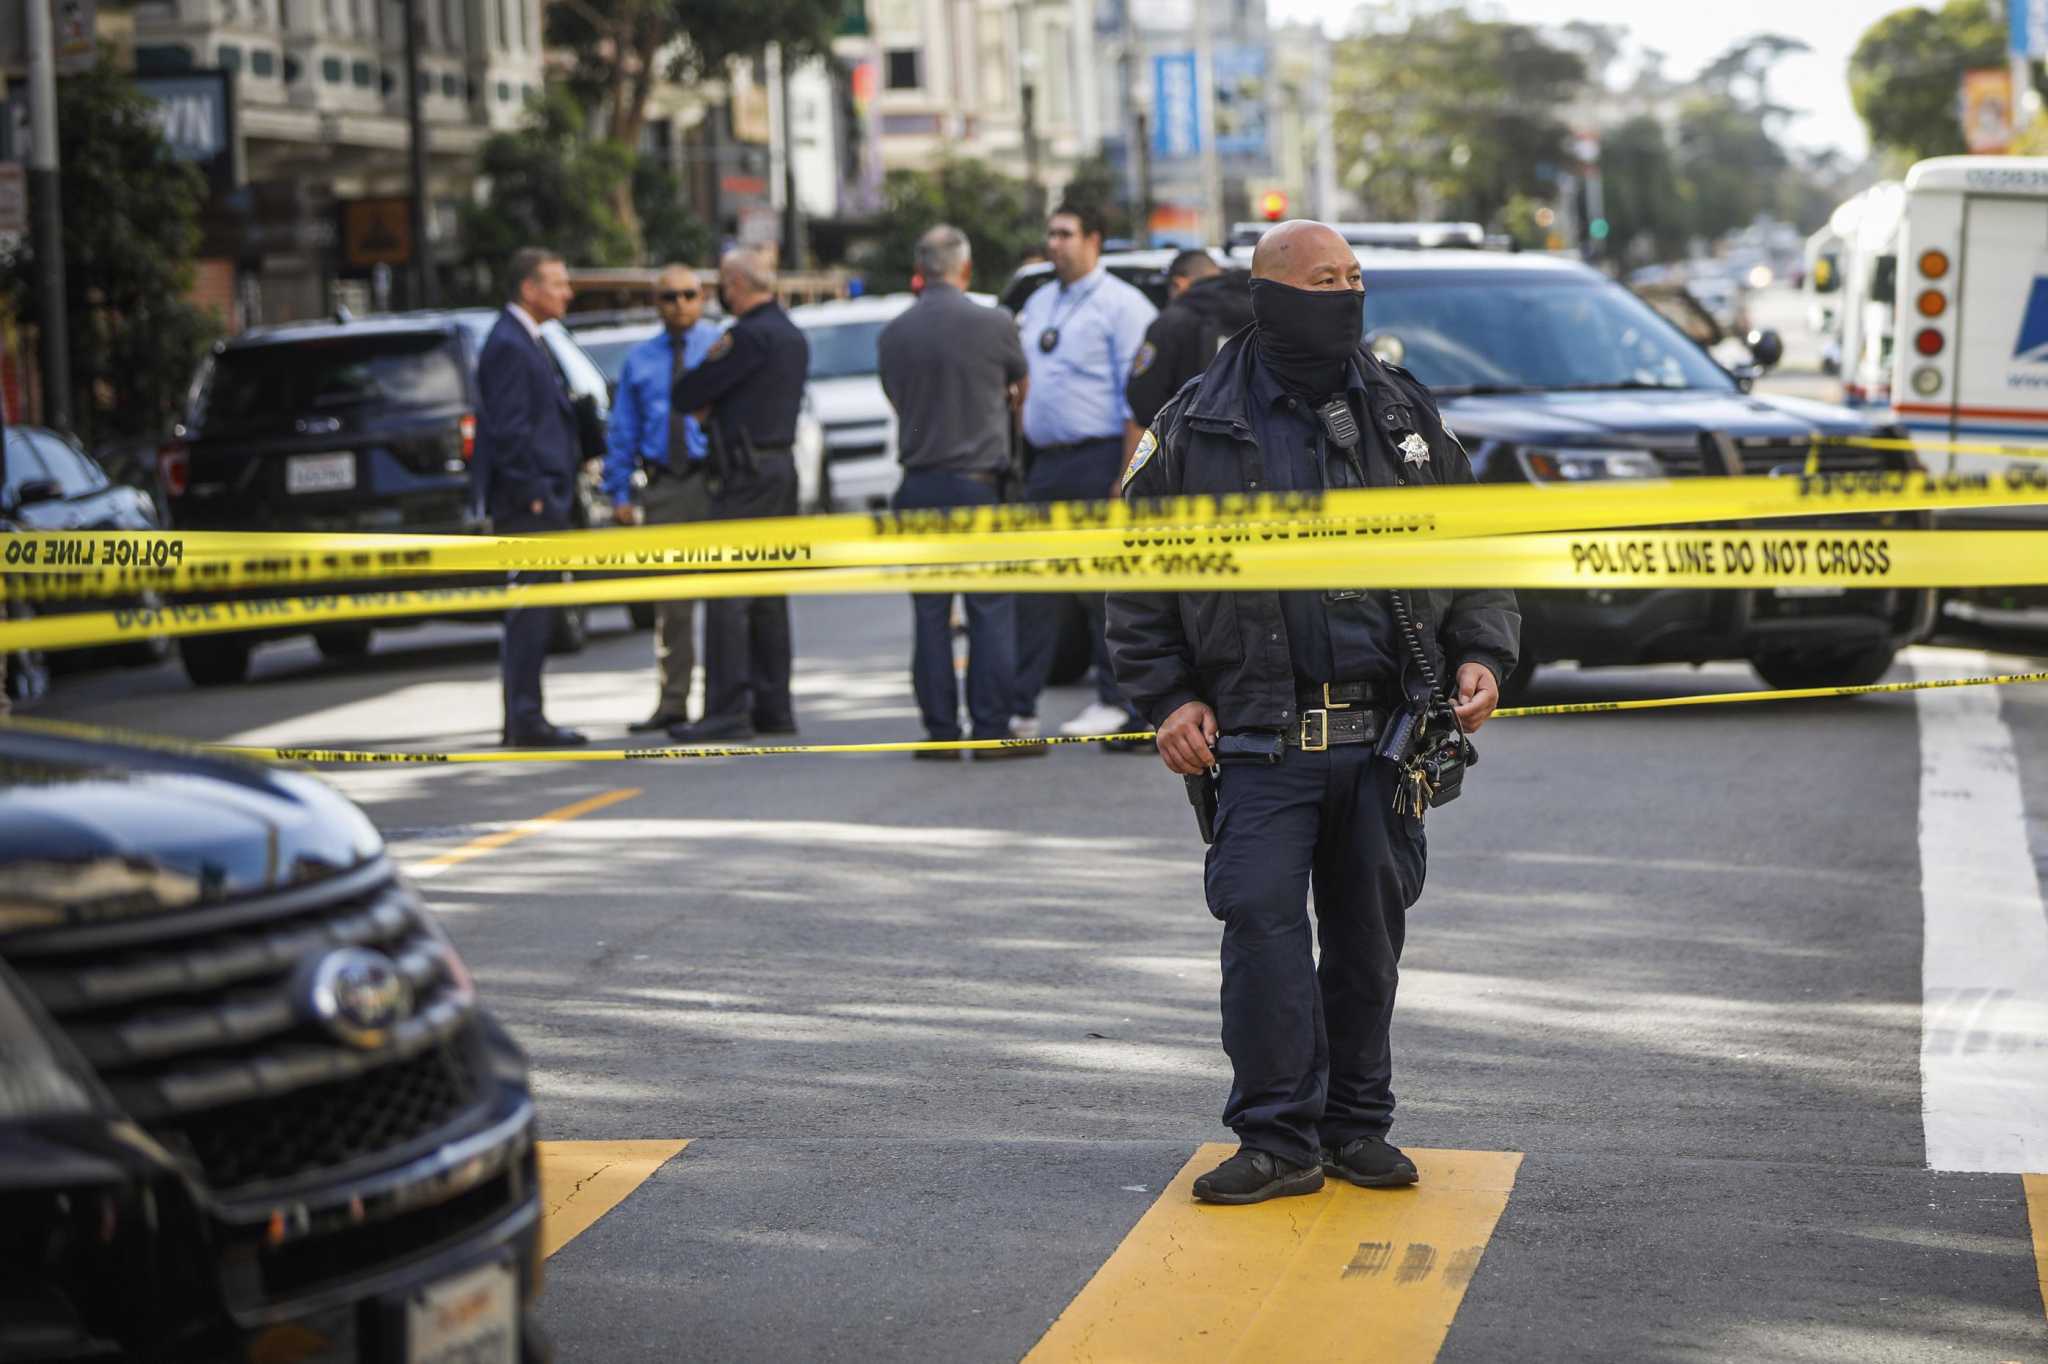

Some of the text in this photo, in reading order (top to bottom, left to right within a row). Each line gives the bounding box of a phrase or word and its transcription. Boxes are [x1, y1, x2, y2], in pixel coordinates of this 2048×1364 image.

[1571, 538, 1891, 576] POLICE LINE DO NOT CROSS
